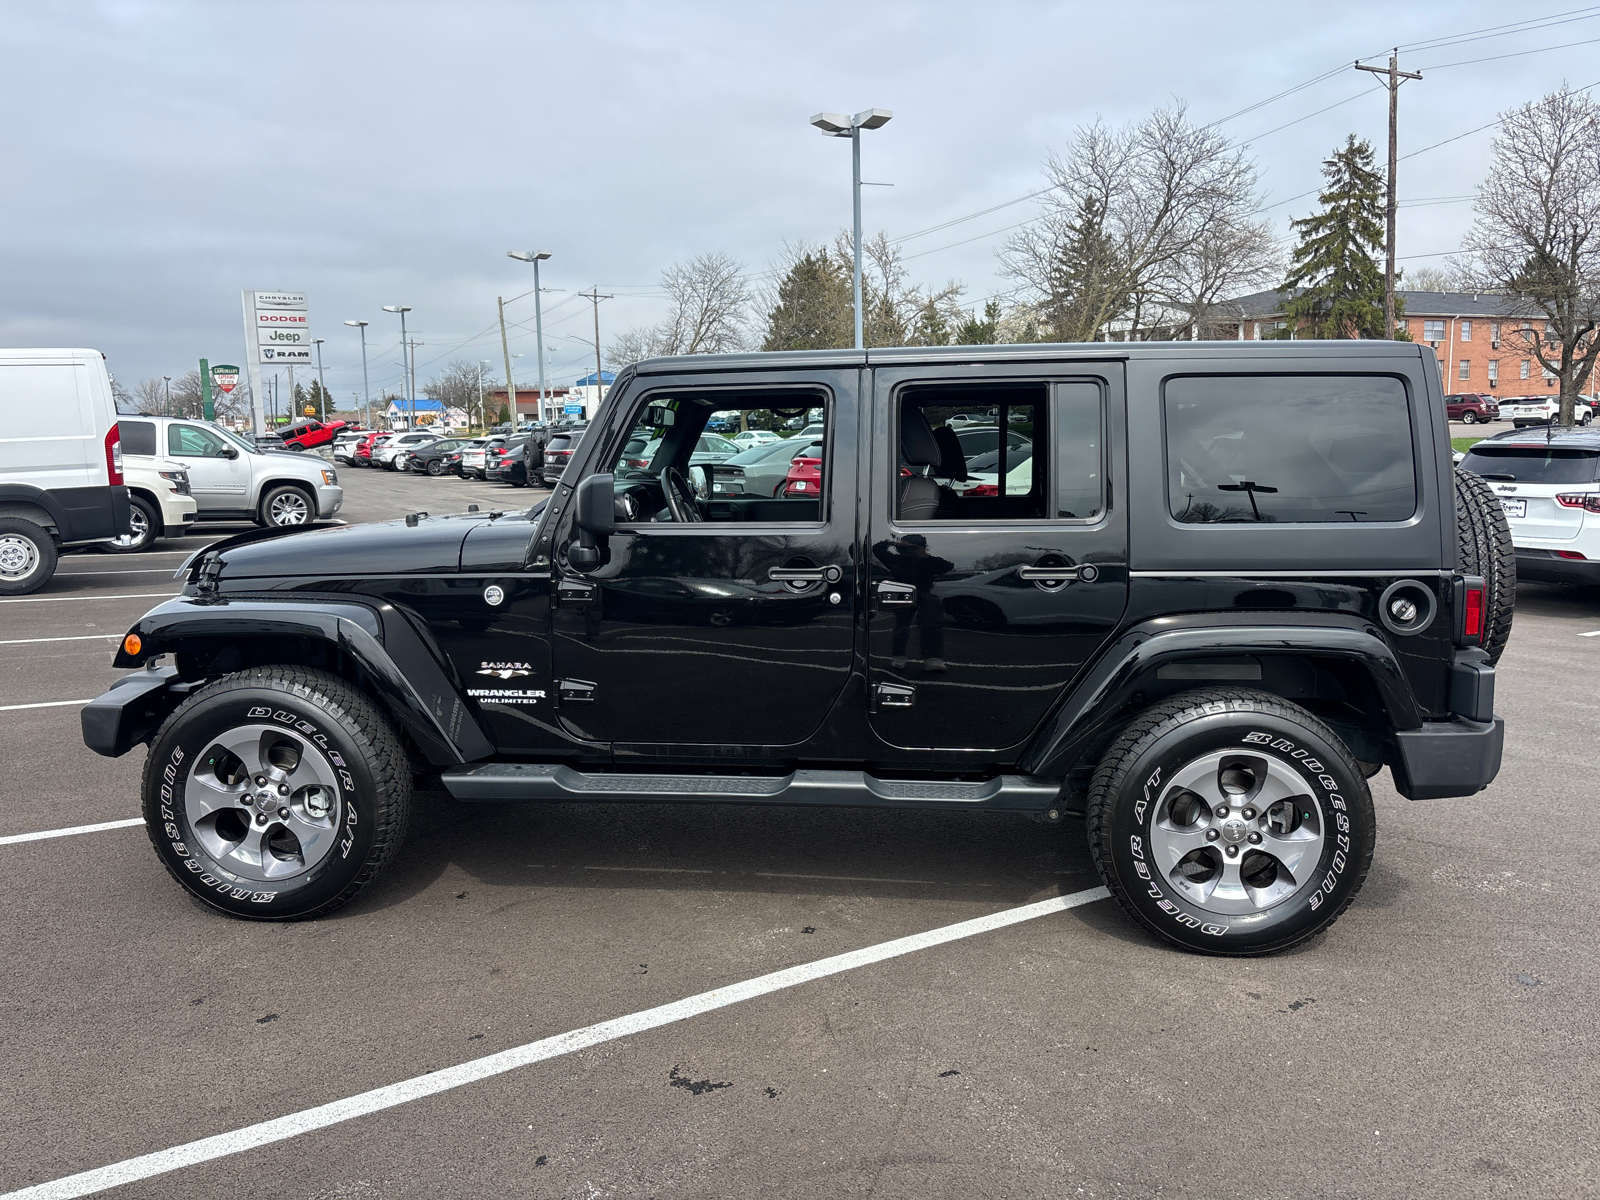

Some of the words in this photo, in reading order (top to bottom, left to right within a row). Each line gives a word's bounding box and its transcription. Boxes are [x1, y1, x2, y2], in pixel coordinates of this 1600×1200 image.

[260, 315, 307, 323] DODGE
[269, 330, 301, 343] Jeep
[466, 689, 547, 698] WRANGLER
[480, 661, 532, 669] SAHARA
[247, 706, 355, 792] DUELER
[340, 801, 358, 859] A/T
[1134, 766, 1162, 825] A/T
[160, 745, 278, 903] BRIDGESTONE
[1242, 731, 1350, 911] BRIDGESTONE
[1131, 835, 1230, 936] DUELER
